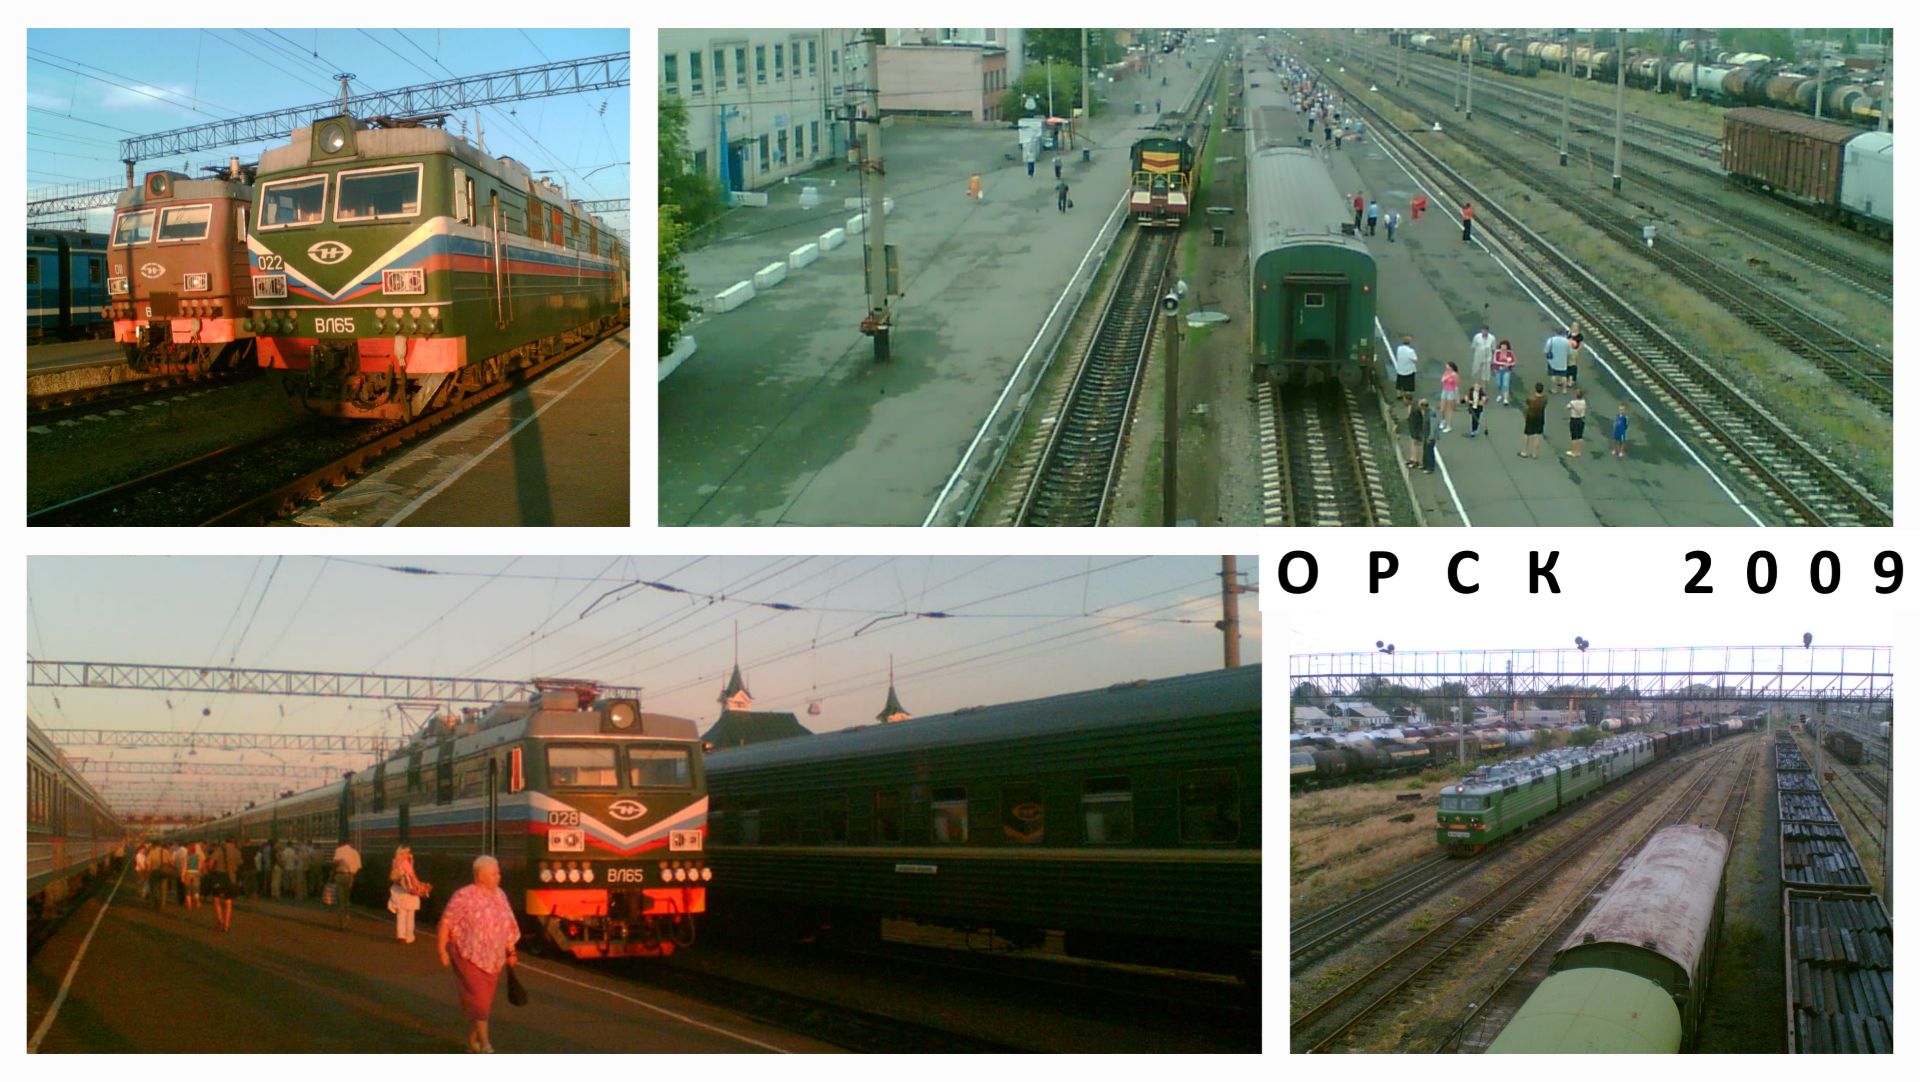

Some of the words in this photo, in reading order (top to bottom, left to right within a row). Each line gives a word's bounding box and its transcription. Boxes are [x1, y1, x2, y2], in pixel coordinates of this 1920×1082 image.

[258, 255, 283, 271] 022
[315, 317, 355, 333] ВЛ65
[549, 811, 580, 825] 028
[607, 868, 643, 883] ВЛ65
